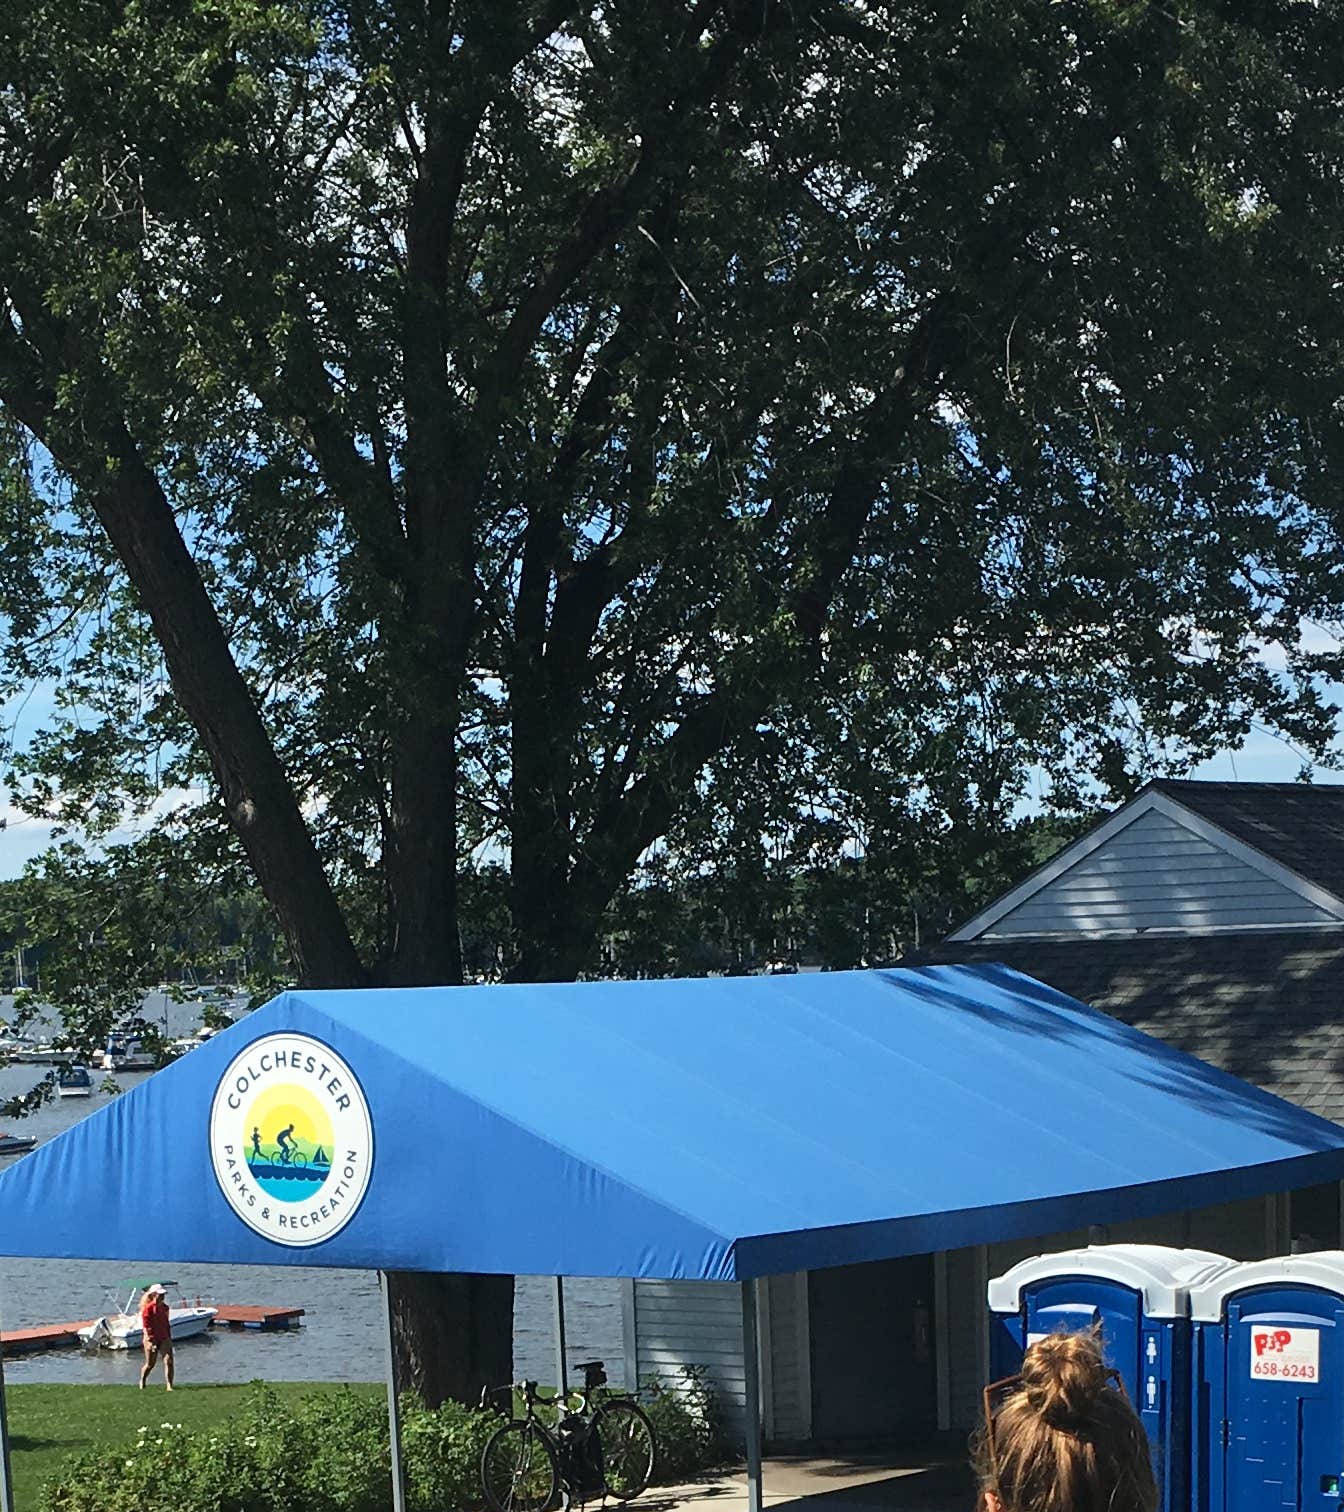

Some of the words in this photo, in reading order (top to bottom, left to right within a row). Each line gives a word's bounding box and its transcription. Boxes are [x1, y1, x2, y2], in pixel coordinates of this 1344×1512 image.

[227, 1050, 351, 1112] COLCHESTER
[224, 1144, 256, 1207] PARKS
[261, 1207, 270, 1220] &
[279, 1149, 357, 1229] RECREATION
[1254, 1361, 1315, 1379] 658-6243
